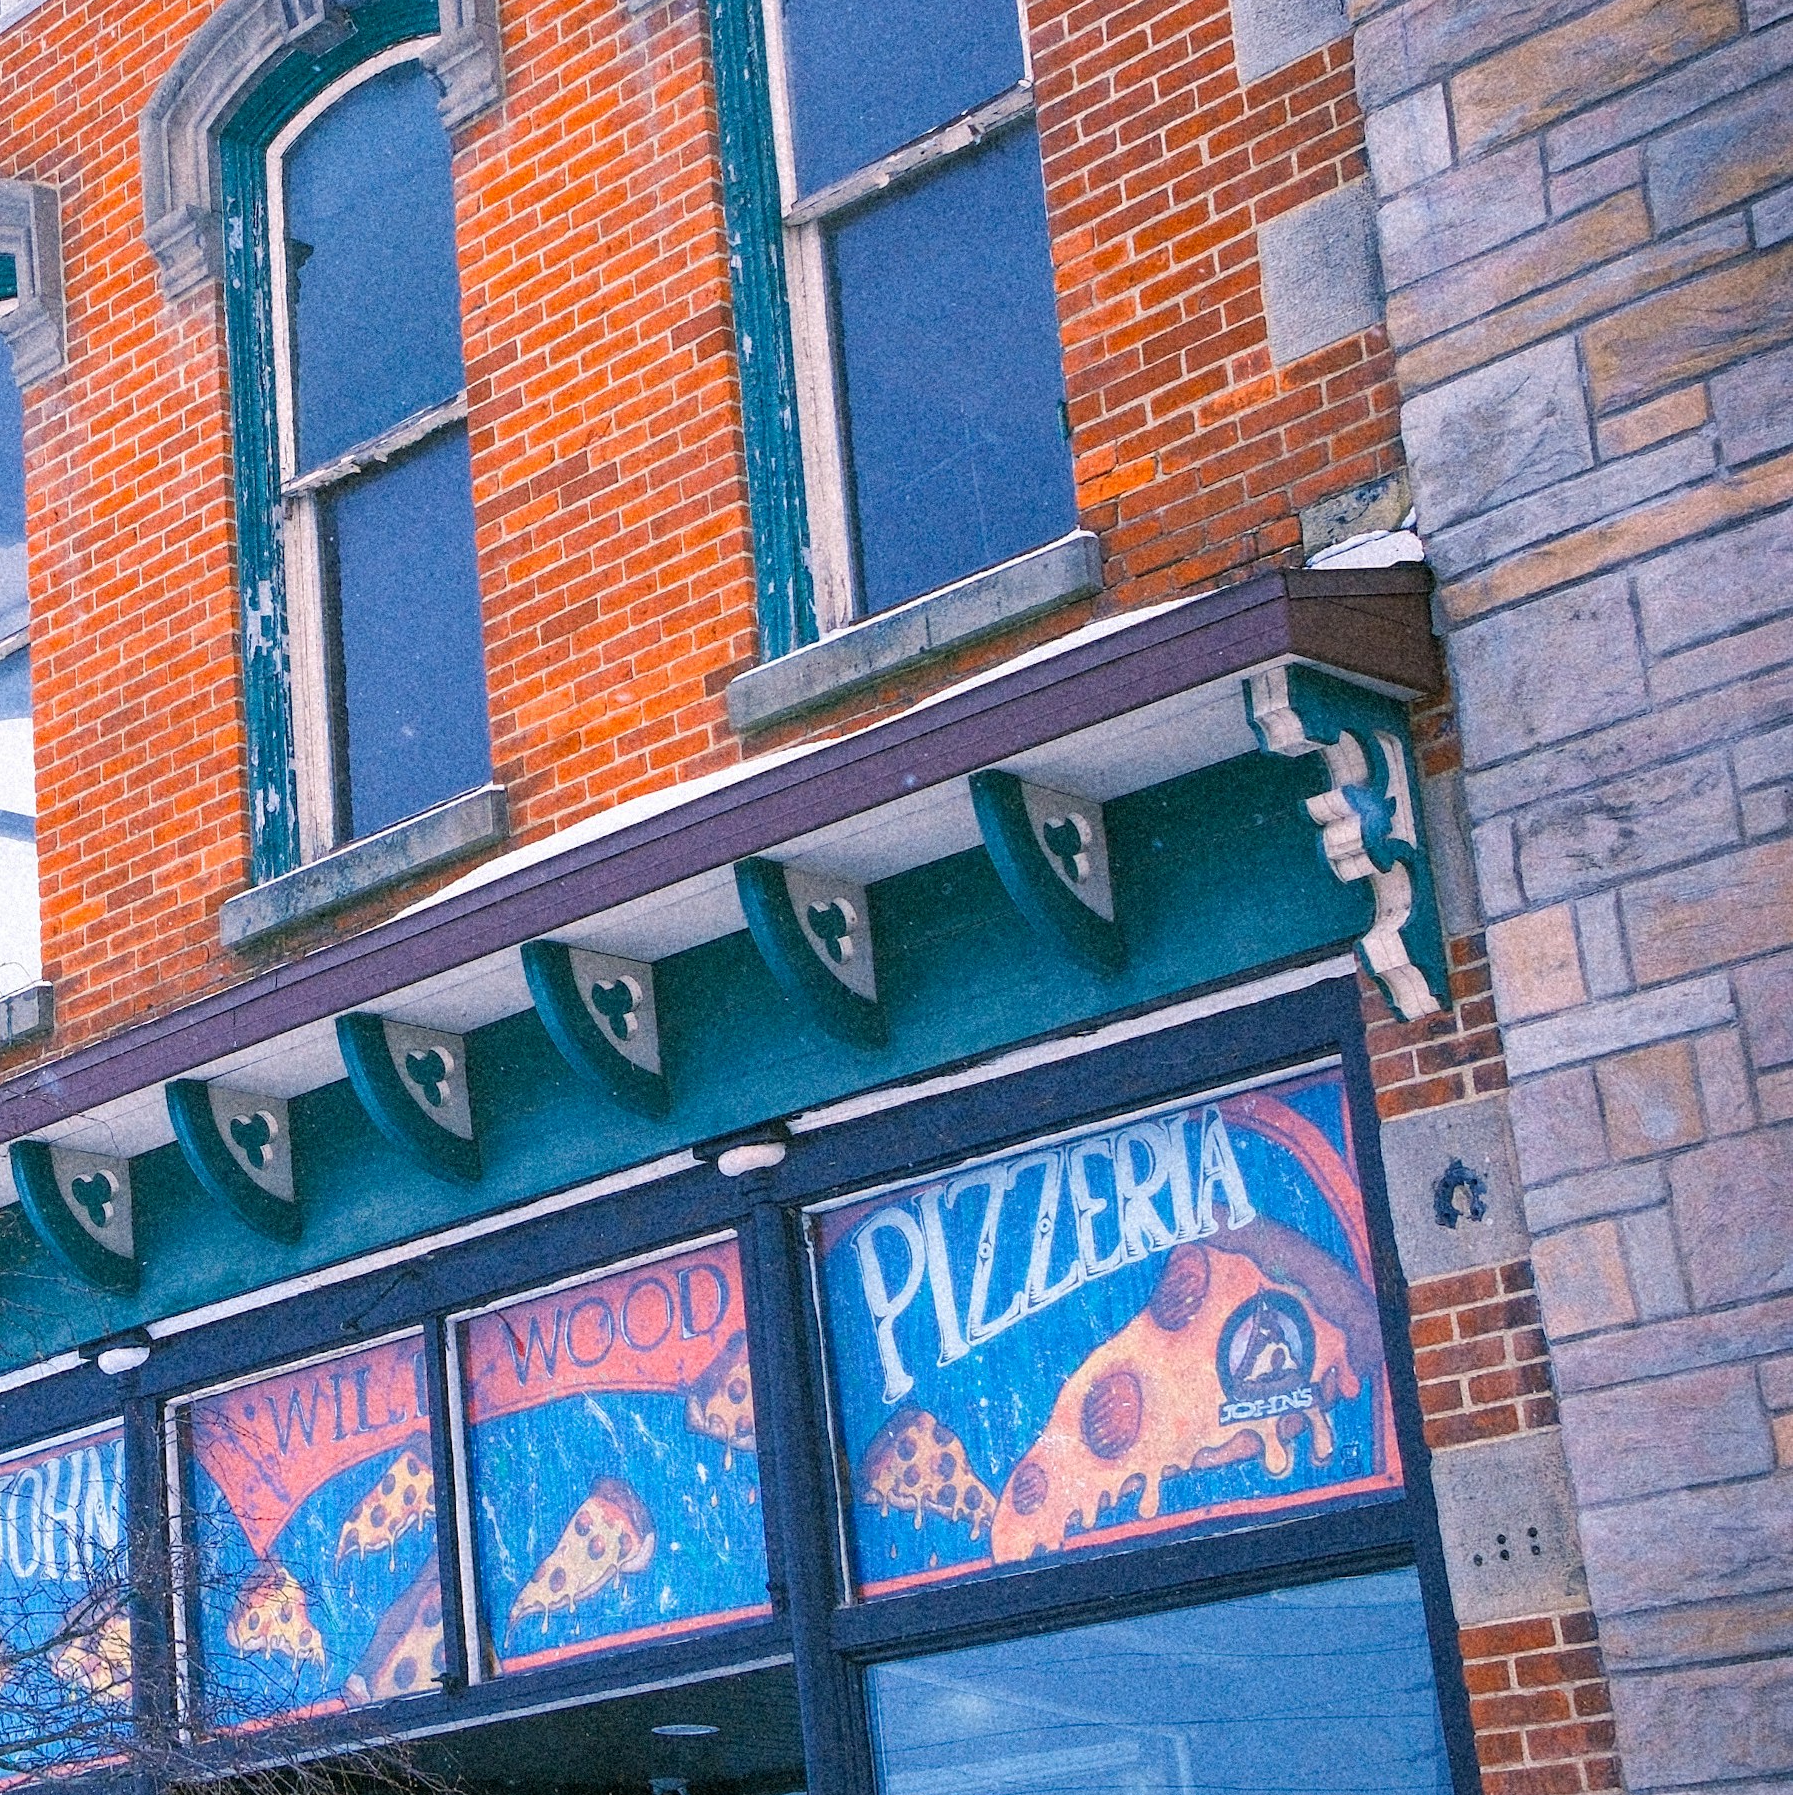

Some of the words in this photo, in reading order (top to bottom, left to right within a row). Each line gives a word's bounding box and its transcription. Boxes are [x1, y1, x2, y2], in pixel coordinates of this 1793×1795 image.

[851, 1103, 1256, 1405] PIZZERIA
[498, 1263, 730, 1387] WOOD
[1219, 1387, 1312, 1424] JOHN'S
